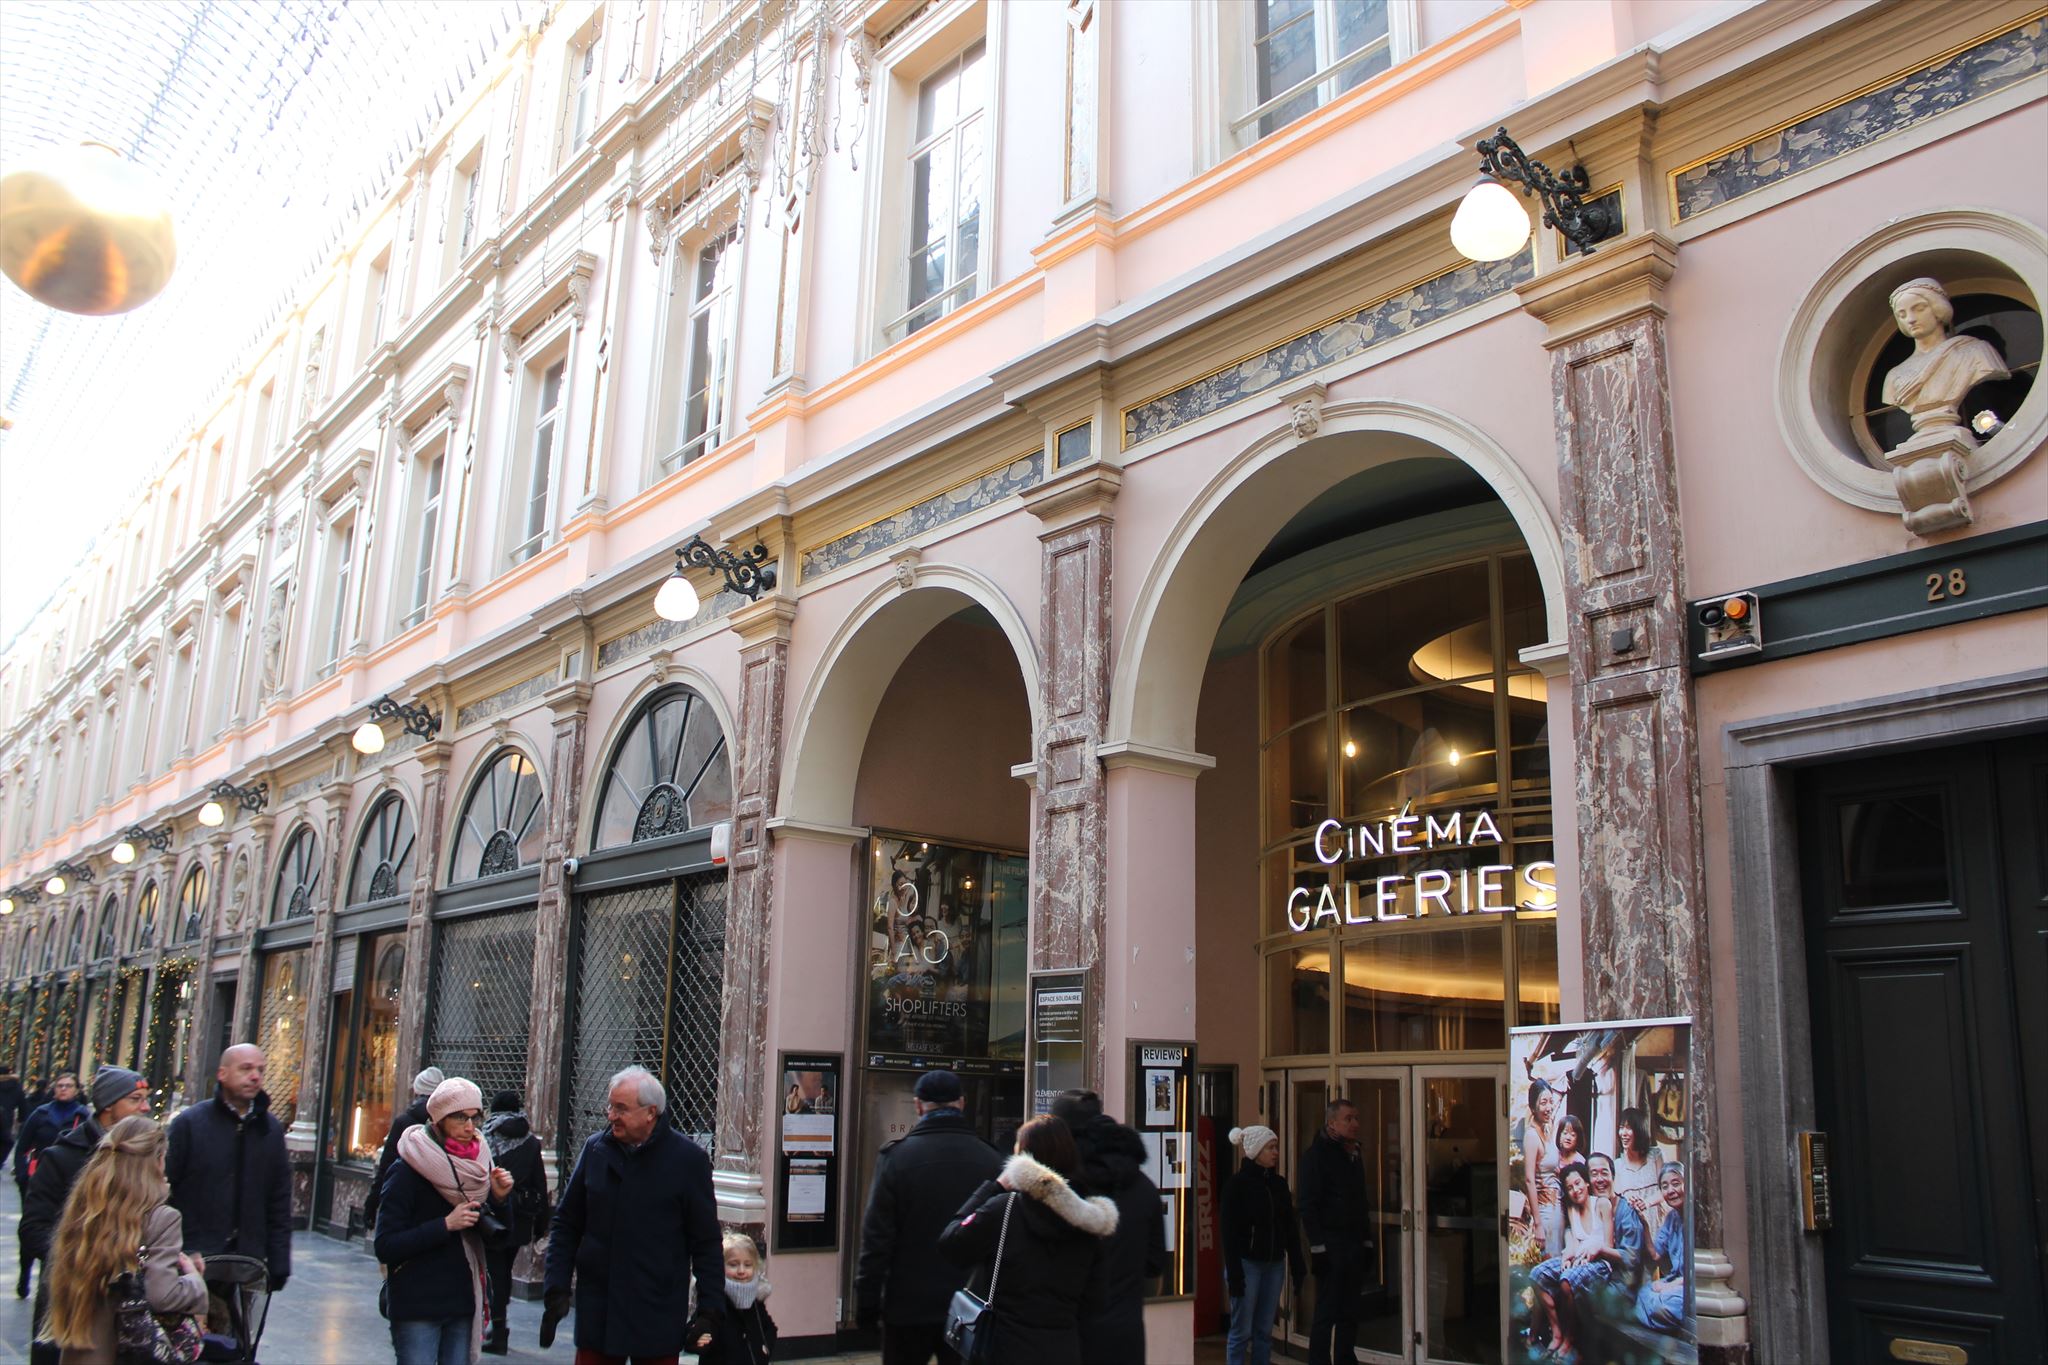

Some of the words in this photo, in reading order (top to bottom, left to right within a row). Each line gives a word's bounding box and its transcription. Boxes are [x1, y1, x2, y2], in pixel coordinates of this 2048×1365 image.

[1926, 568, 1966, 602] 28
[1314, 797, 1503, 864] CINÉMA
[1287, 861, 1557, 932] GALERIES
[885, 997, 967, 1017] SHOPLIFTERS
[1143, 1049, 1181, 1061] REVIEWS
[1198, 1140, 1213, 1251] BRUZZ
